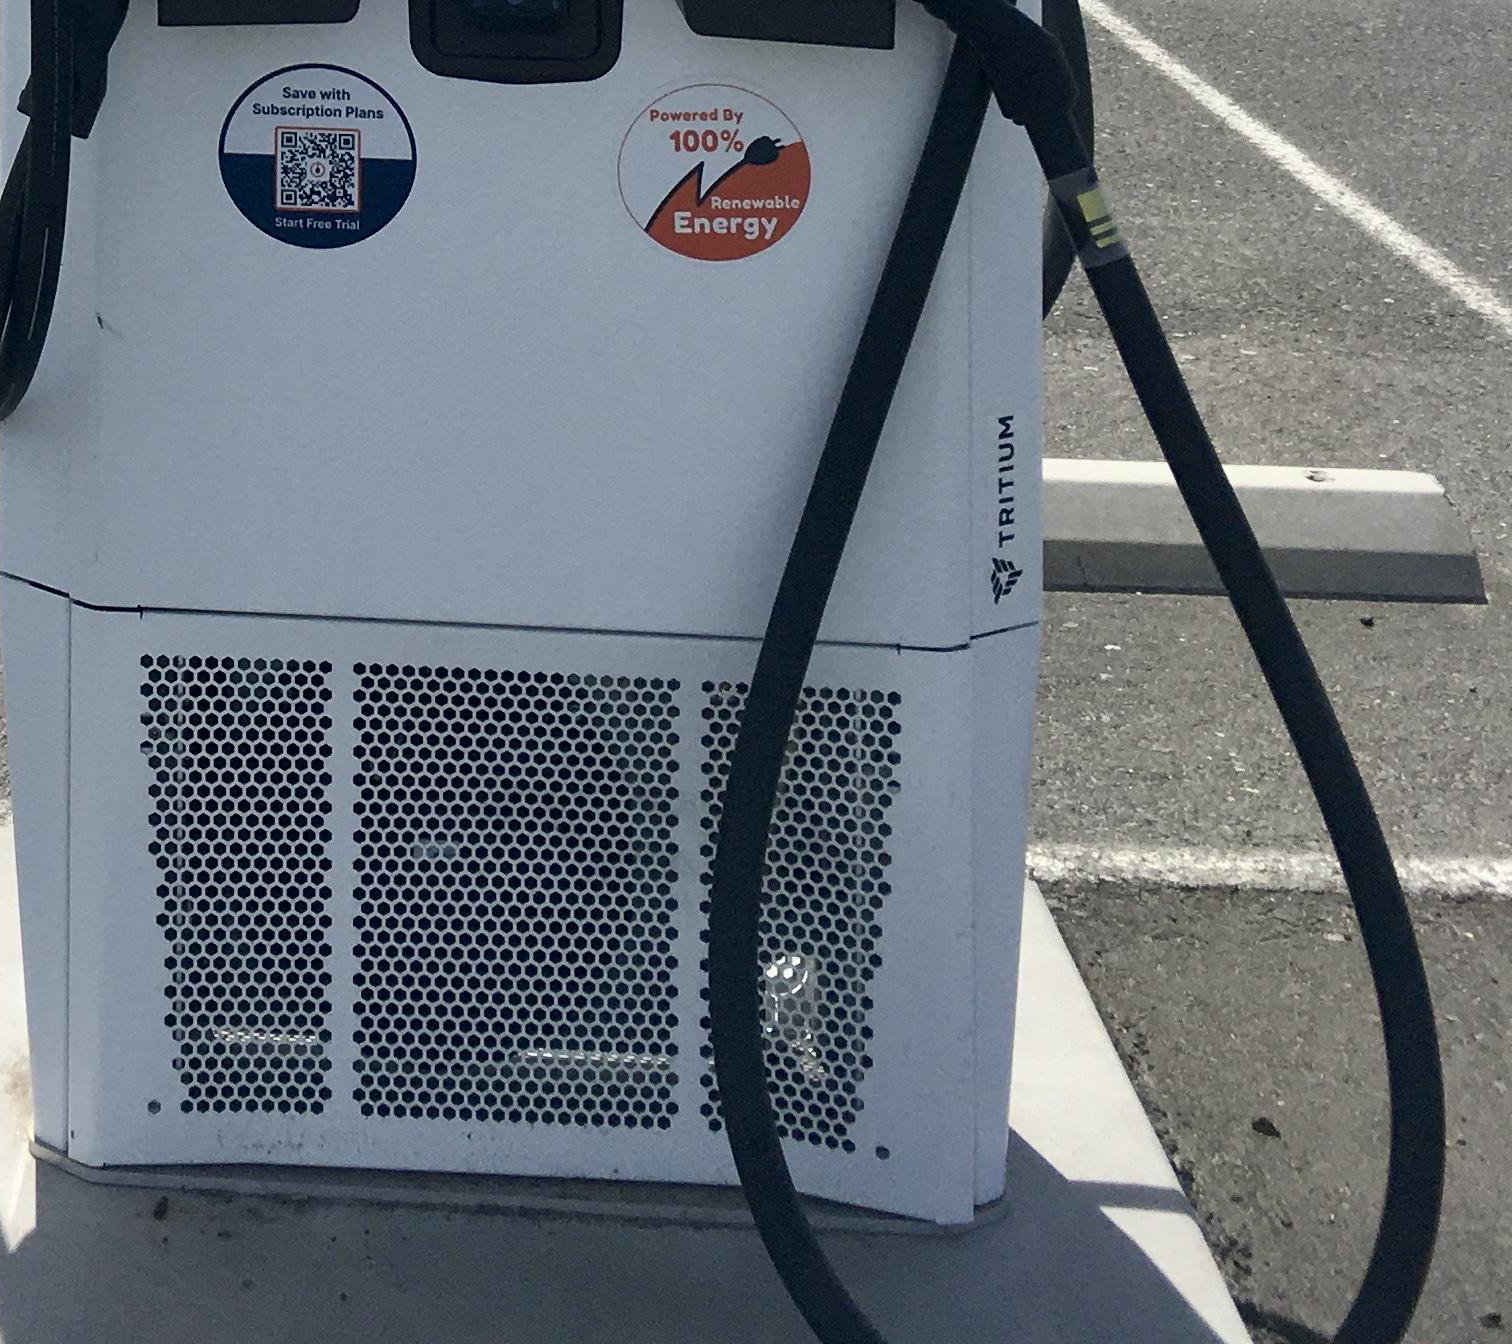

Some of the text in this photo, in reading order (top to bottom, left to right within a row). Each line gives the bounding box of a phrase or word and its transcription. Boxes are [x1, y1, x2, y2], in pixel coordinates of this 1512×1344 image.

[283, 87, 350, 100] Save with
[253, 103, 383, 119] Subscription Plans
[650, 108, 743, 125] Powered By
[669, 129, 744, 152] 100%
[711, 195, 799, 209] Renewable
[275, 218, 359, 229] Start Free Trial
[674, 212, 777, 239] Energy
[999, 416, 1014, 548] TRITIUM
